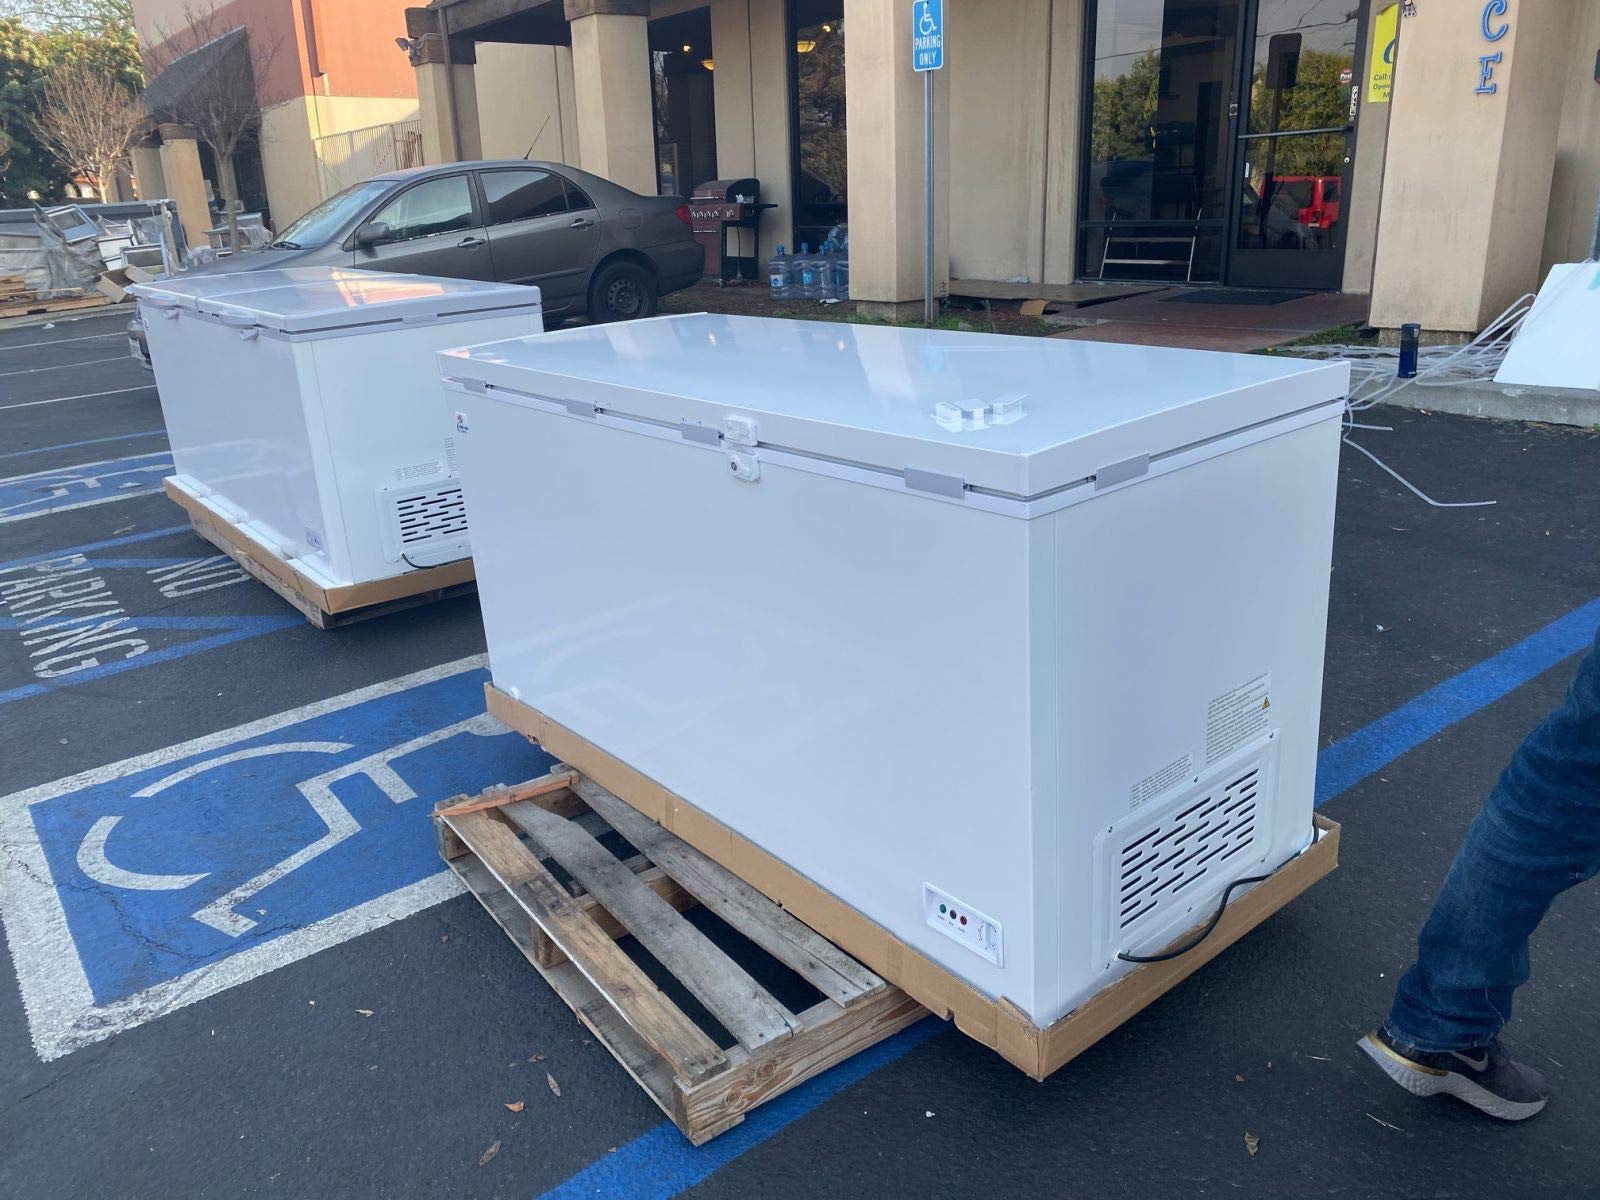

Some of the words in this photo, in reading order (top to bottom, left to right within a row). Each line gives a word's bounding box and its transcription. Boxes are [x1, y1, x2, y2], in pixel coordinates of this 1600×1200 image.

[915, 34, 941, 50] PARKING
[919, 51, 937, 66] ONLY
[146, 554, 251, 598] NO
[0, 554, 149, 678] PARKING
